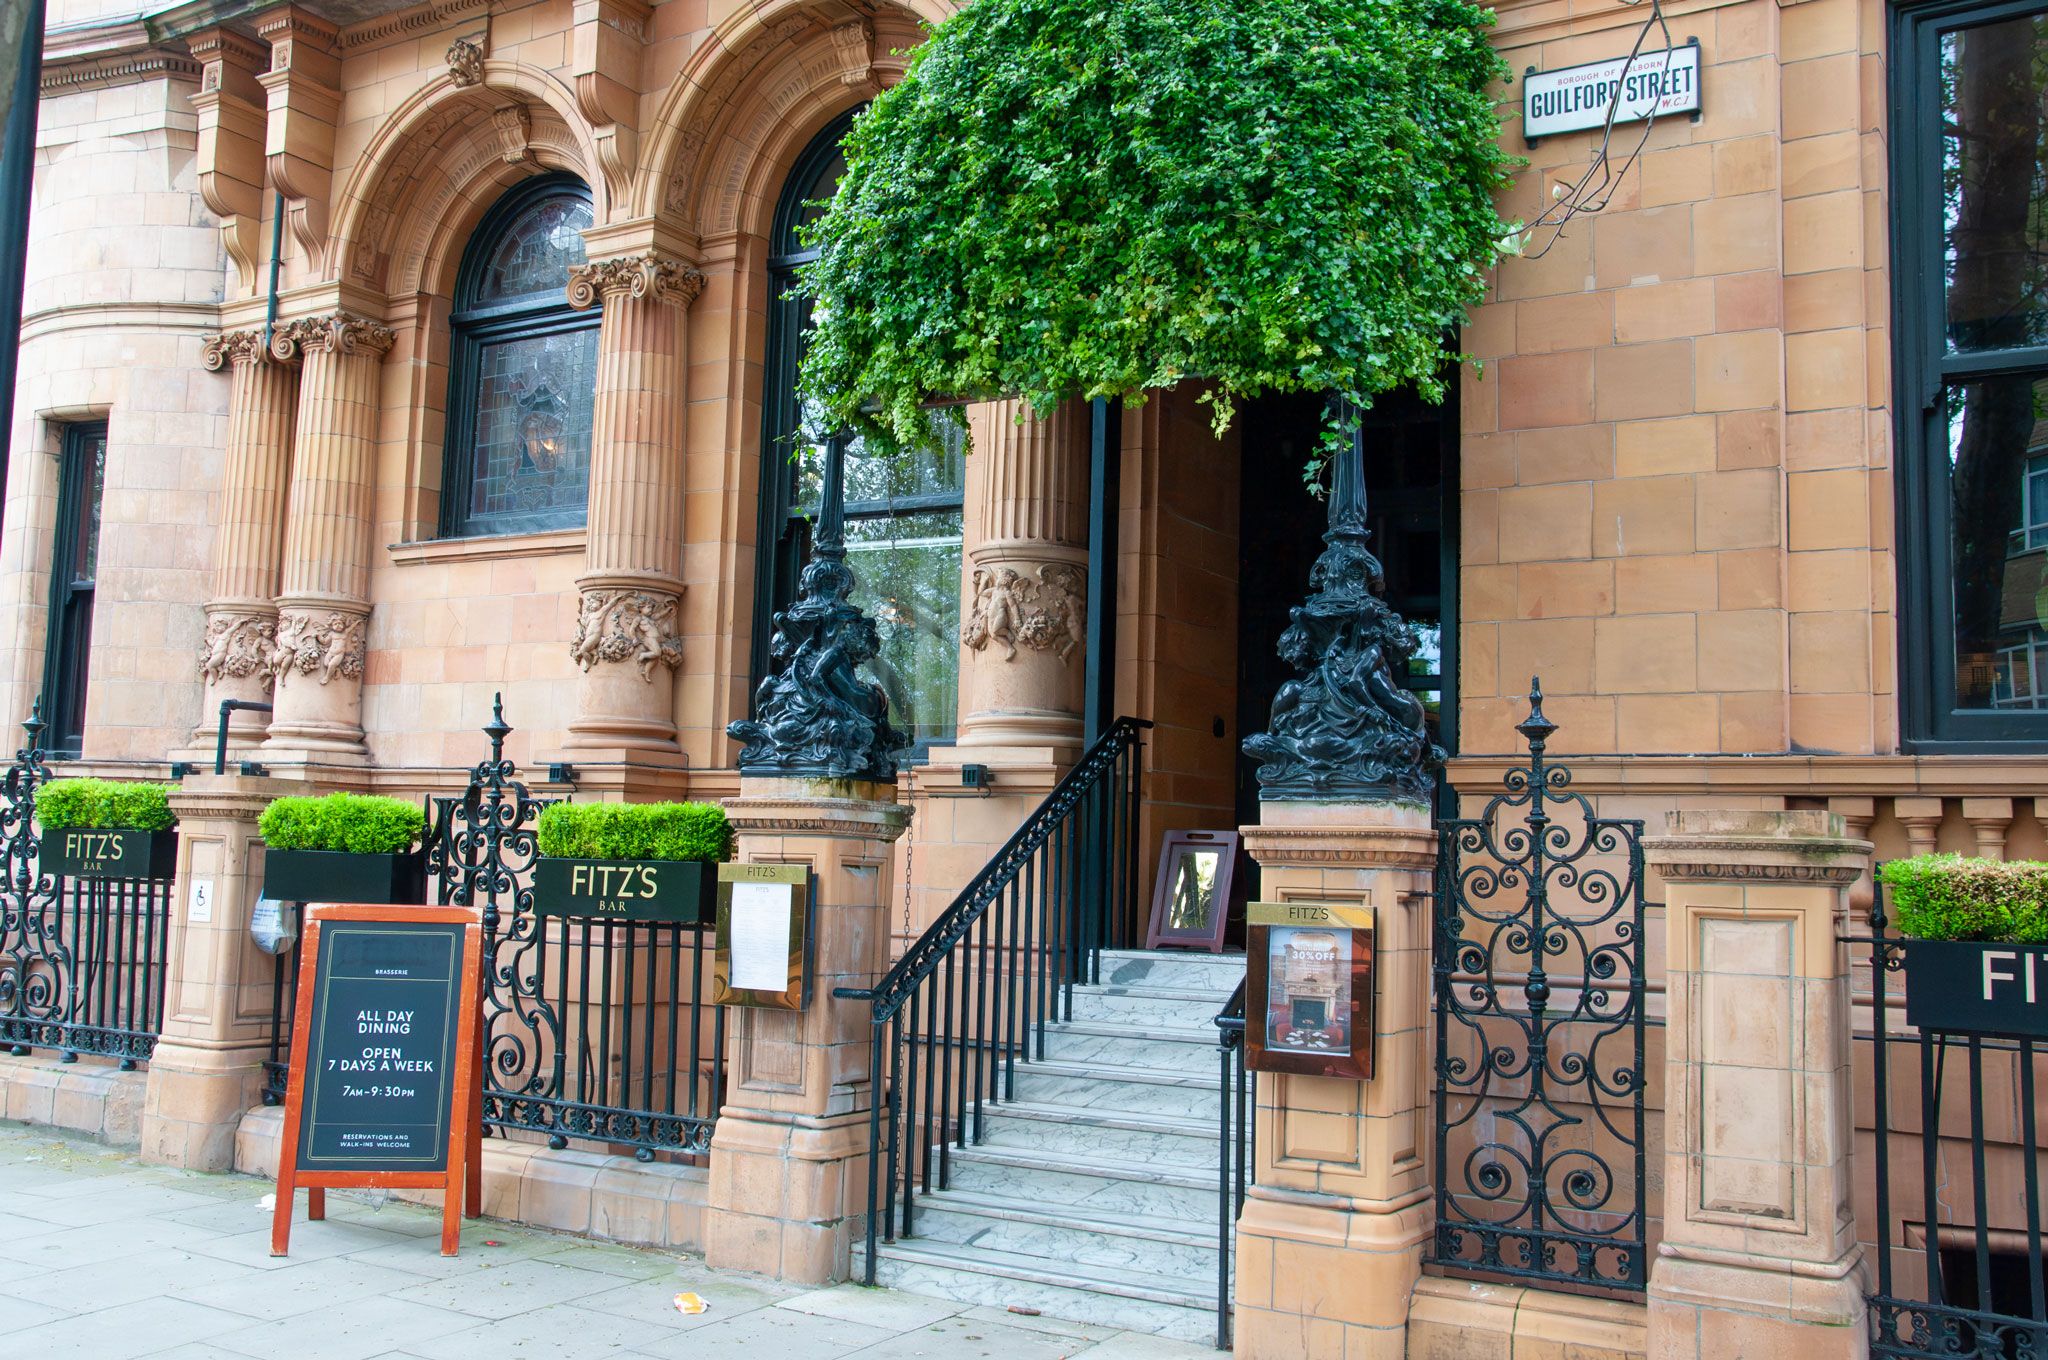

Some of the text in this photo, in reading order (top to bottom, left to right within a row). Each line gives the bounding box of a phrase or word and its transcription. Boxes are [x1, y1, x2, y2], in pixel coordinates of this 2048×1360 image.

[1557, 71, 1600, 86] BOROUGH
[1603, 68, 1616, 78] OF
[1531, 65, 1693, 119] GUILFORD STREET
[65, 832, 123, 861] FITZ'S
[83, 861, 103, 871] BAR
[747, 866, 776, 878] FITZ'S
[571, 864, 658, 898] FITZ'S
[599, 900, 626, 912] BAR
[1289, 907, 1329, 920] FITZ'S
[1982, 951, 2048, 1003] FI
[357, 1010, 414, 1022] ALL DAY
[358, 1022, 411, 1034] DINING
[362, 1047, 401, 1060] OPEN
[328, 1059, 433, 1072] 7 DAYS A WEEK
